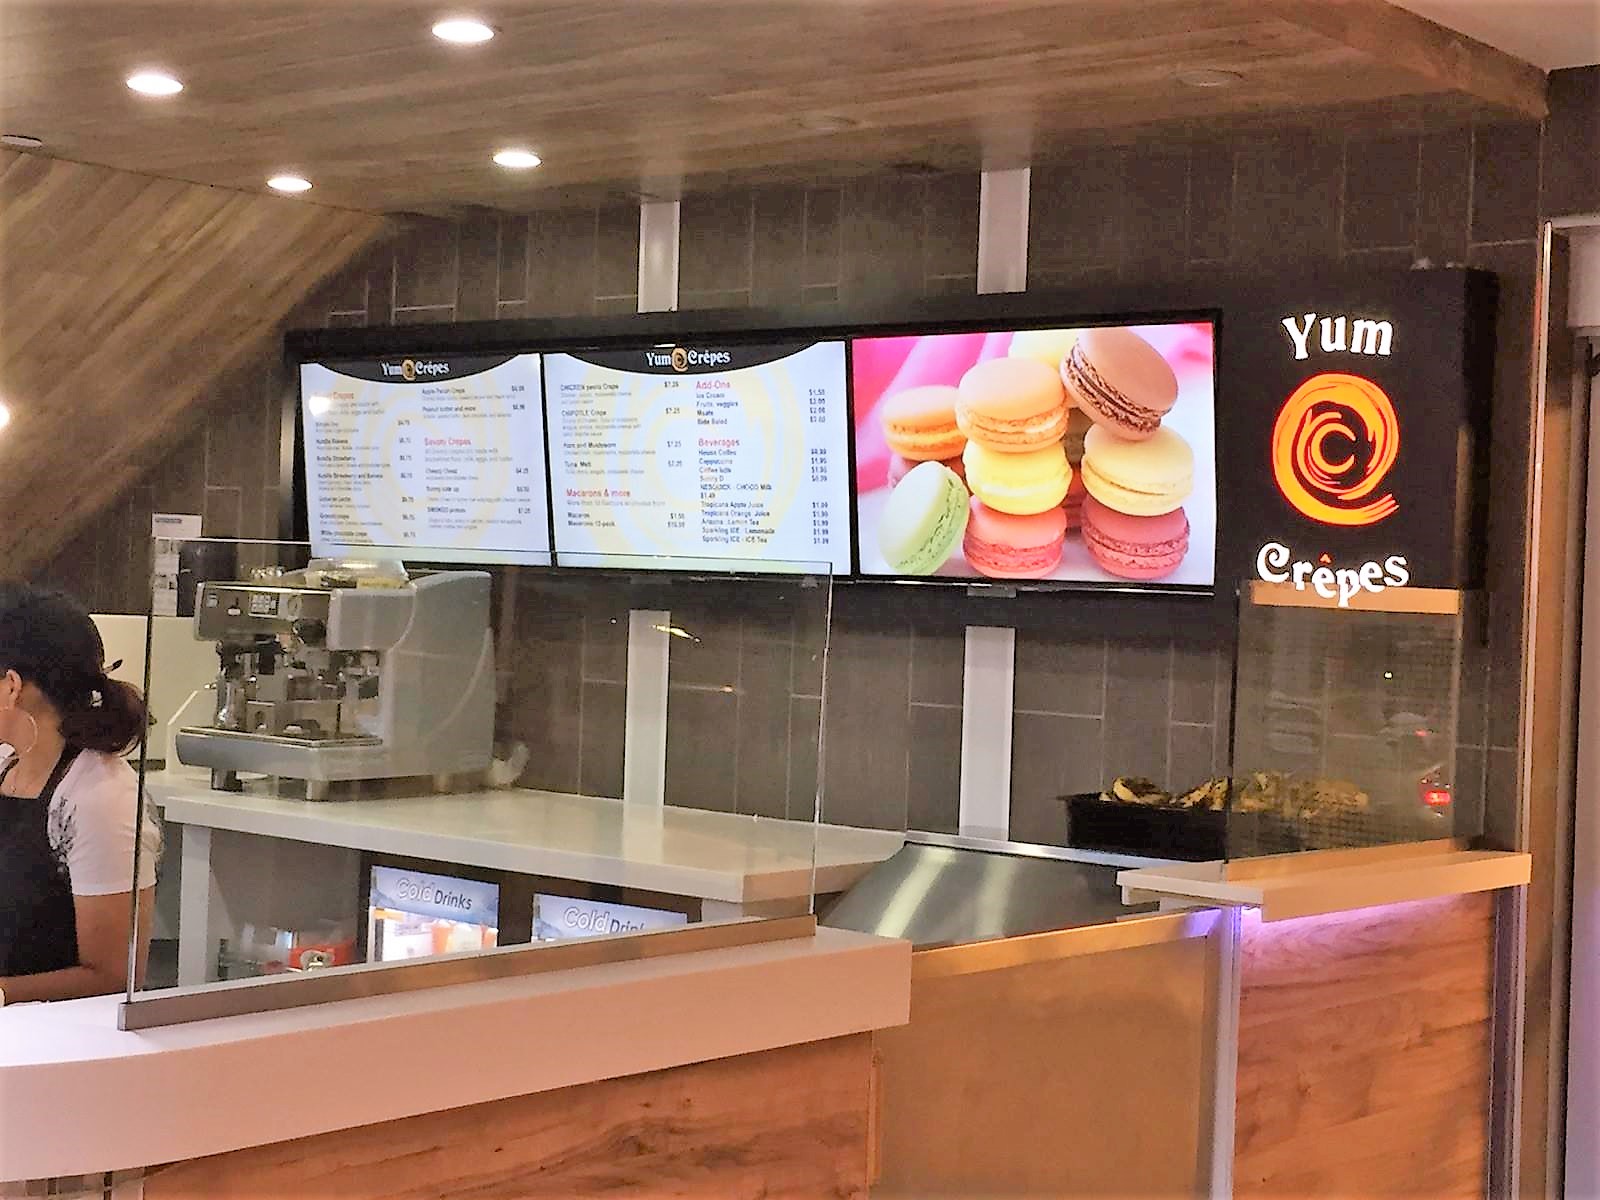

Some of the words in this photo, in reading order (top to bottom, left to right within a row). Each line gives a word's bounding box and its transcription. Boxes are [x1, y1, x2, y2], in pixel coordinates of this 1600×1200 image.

[1281, 312, 1393, 360] Yum
[381, 362, 402, 376] Yum
[646, 352, 672, 366] Yum
[698, 438, 740, 447] Beverages
[566, 488, 601, 497] Macarons
[603, 488, 609, 497] &
[611, 489, 631, 497] more
[1256, 542, 1409, 608] Crêpes
[396, 877, 435, 901] Cold
[434, 889, 472, 911] Drinks
[564, 906, 610, 933] Cold
